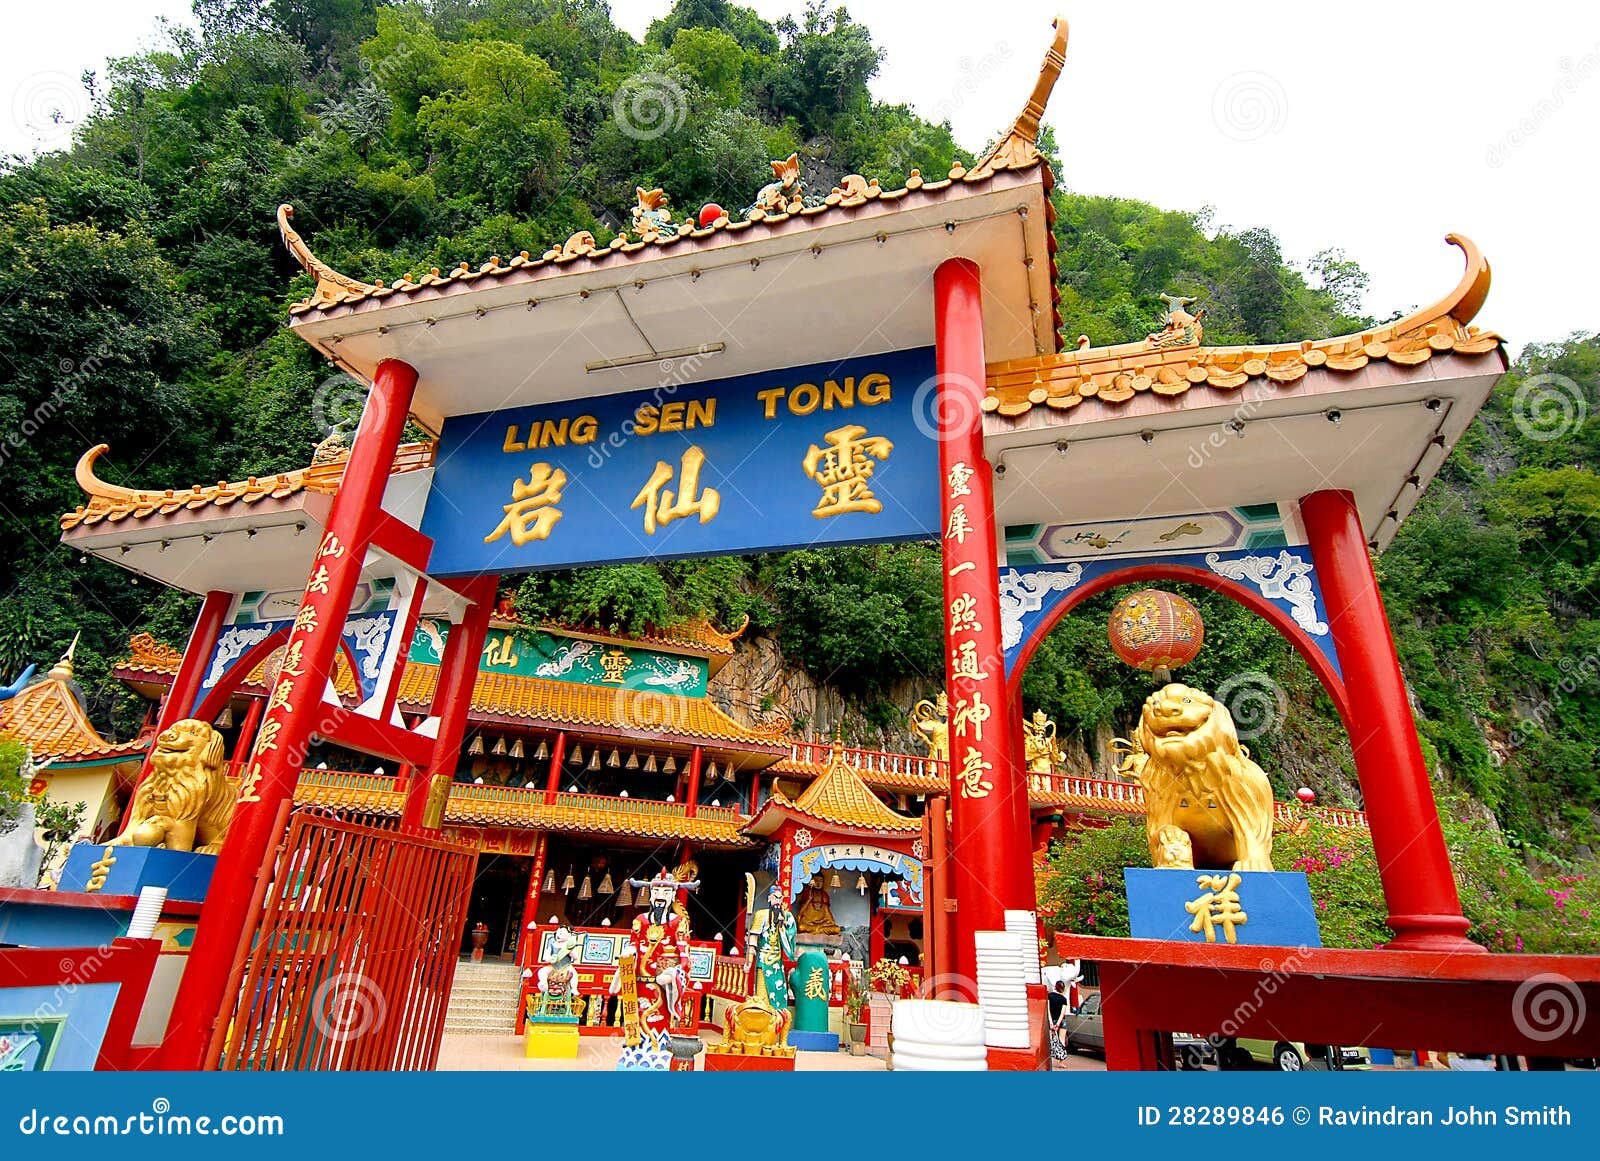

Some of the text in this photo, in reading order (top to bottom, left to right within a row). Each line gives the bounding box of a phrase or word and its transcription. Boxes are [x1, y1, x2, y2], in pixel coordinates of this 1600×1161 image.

[503, 373, 892, 453] LING SEN TONG
[1185, 873, 1248, 944] 祥
[805, 966, 827, 1001] 義
